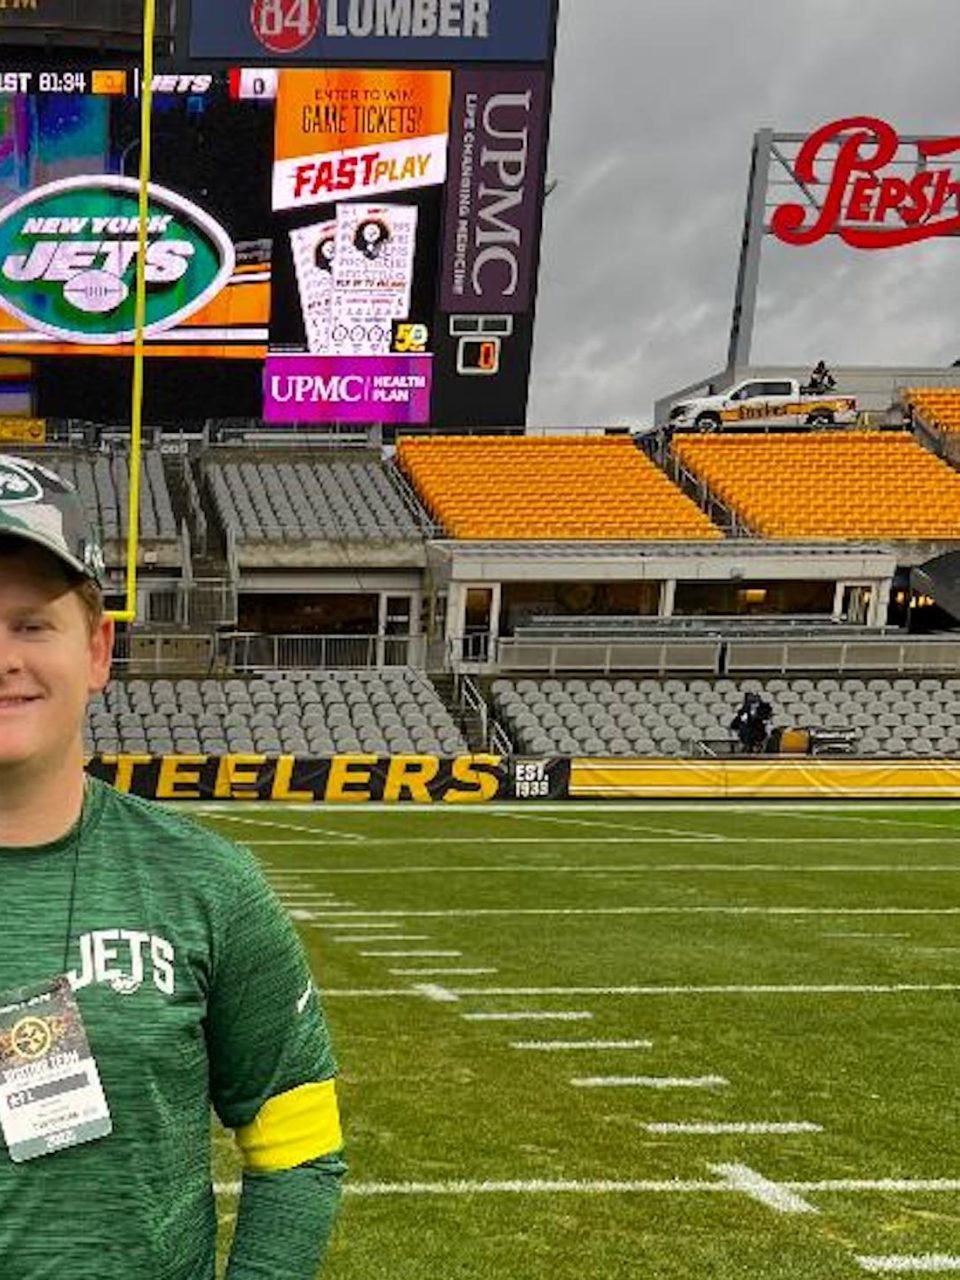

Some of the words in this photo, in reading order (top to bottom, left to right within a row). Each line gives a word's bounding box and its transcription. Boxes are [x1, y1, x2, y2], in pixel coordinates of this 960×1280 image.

[259, 0, 311, 35] 84
[326, 0, 490, 37] LUMBER
[315, 90, 358, 101] ENTER
[364, 90, 380, 101] TO
[385, 90, 415, 101] WIN
[464, 93, 478, 129] LIFE
[303, 106, 347, 134] GAME
[457, 132, 475, 216] CHANGING
[471, 89, 532, 296] UPMC
[21, 215, 87, 234] NEW
[1, 240, 196, 282] JETS
[452, 218, 469, 295] MEDICINE
[271, 375, 364, 402] UPMC
[373, 389, 410, 402] PLAN
[374, 375, 426, 388] HEALTH
[100, 753, 502, 803] TEELERS
[515, 763, 549, 781] EST.
[63, 928, 175, 995] JETS
